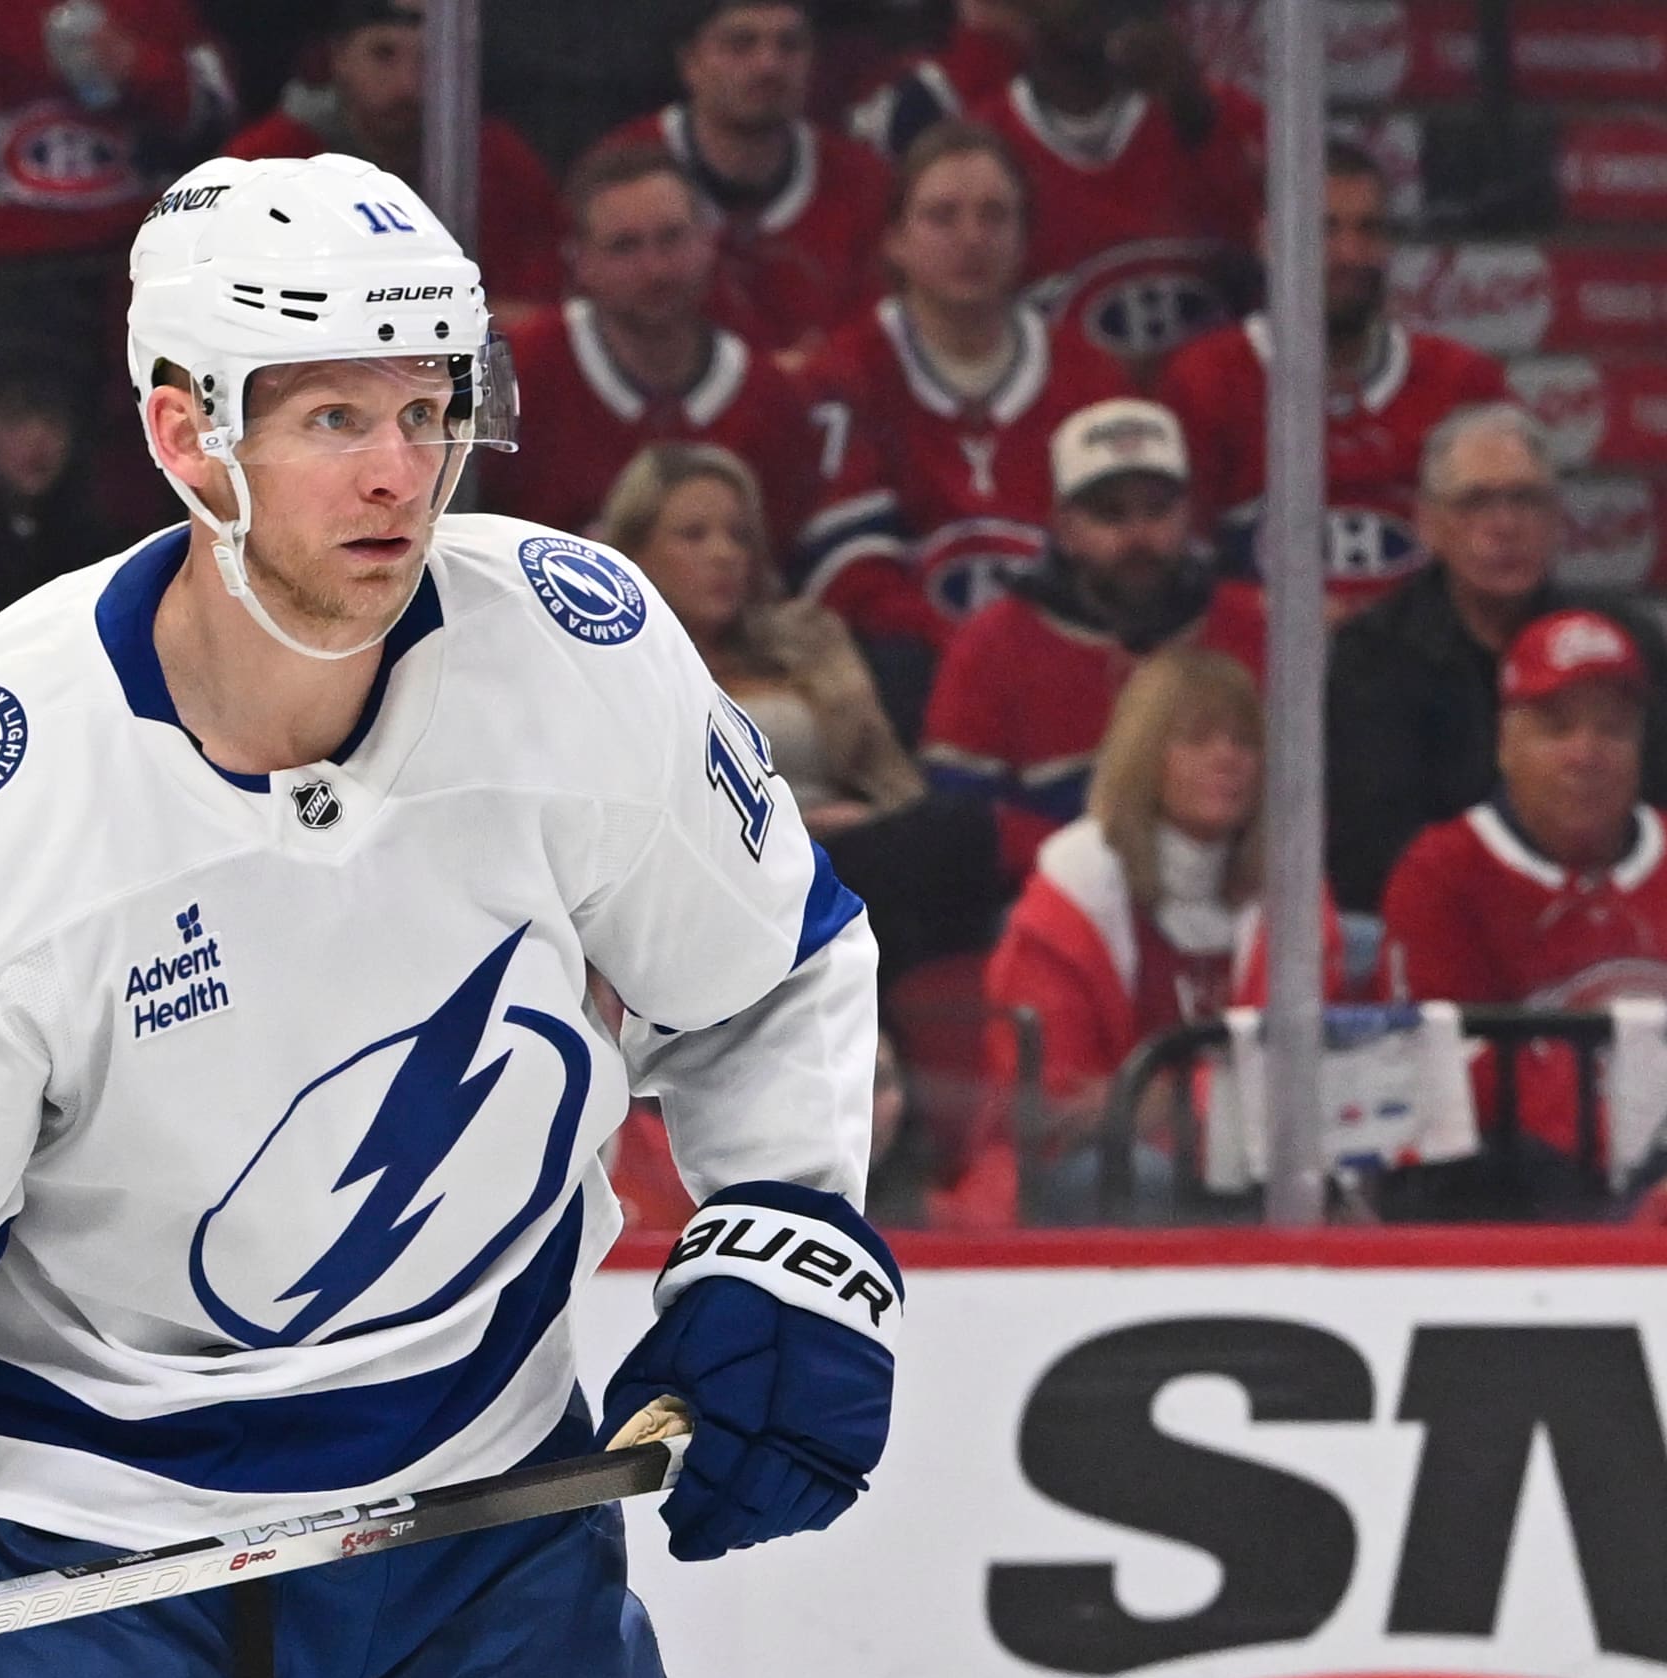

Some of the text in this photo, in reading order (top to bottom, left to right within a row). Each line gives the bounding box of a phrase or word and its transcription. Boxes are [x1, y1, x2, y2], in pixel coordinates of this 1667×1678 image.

[366, 284, 455, 303] BAUER
[531, 576, 565, 616] BAY
[304, 786, 332, 825] NHL
[124, 937, 222, 1003] Advent
[134, 976, 230, 1038] Health
